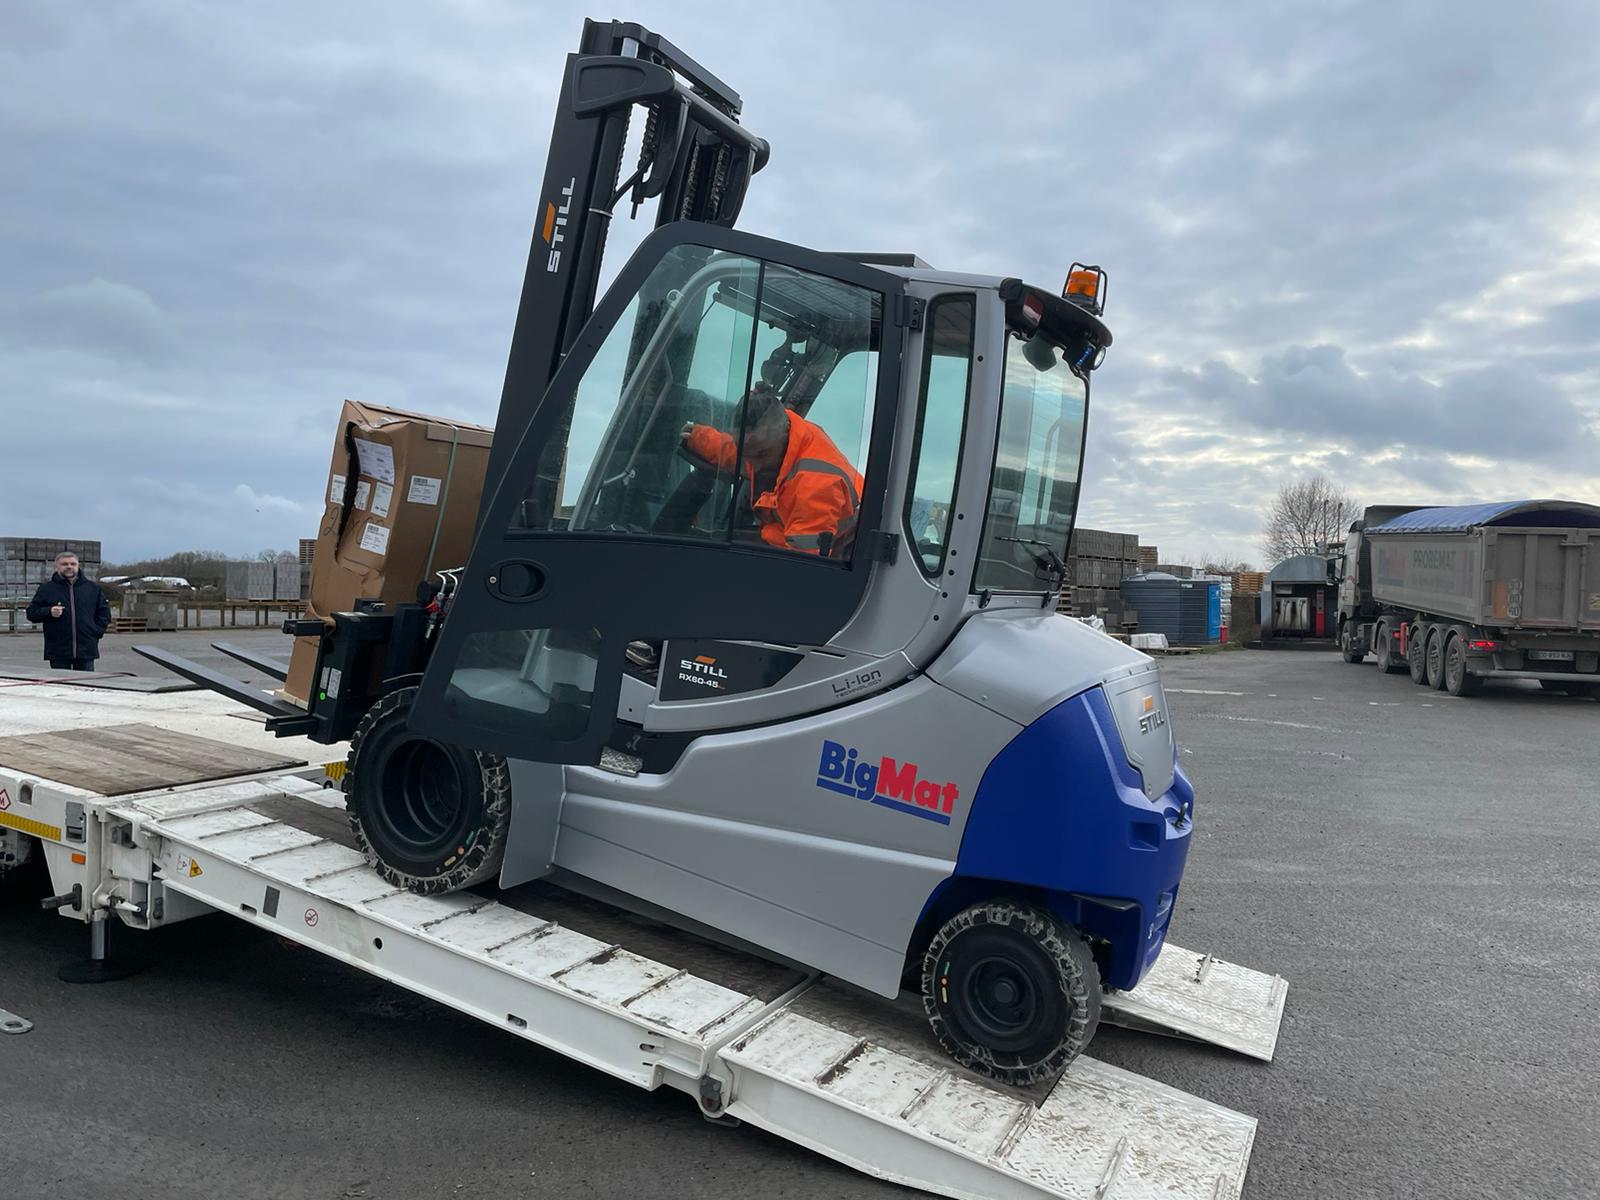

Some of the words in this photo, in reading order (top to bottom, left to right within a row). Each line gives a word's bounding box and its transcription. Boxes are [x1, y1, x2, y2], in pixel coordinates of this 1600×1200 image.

[547, 177, 576, 273] STILL
[680, 659, 728, 679] STILL
[1139, 711, 1165, 734] STILL
[818, 739, 960, 814] BigMat
